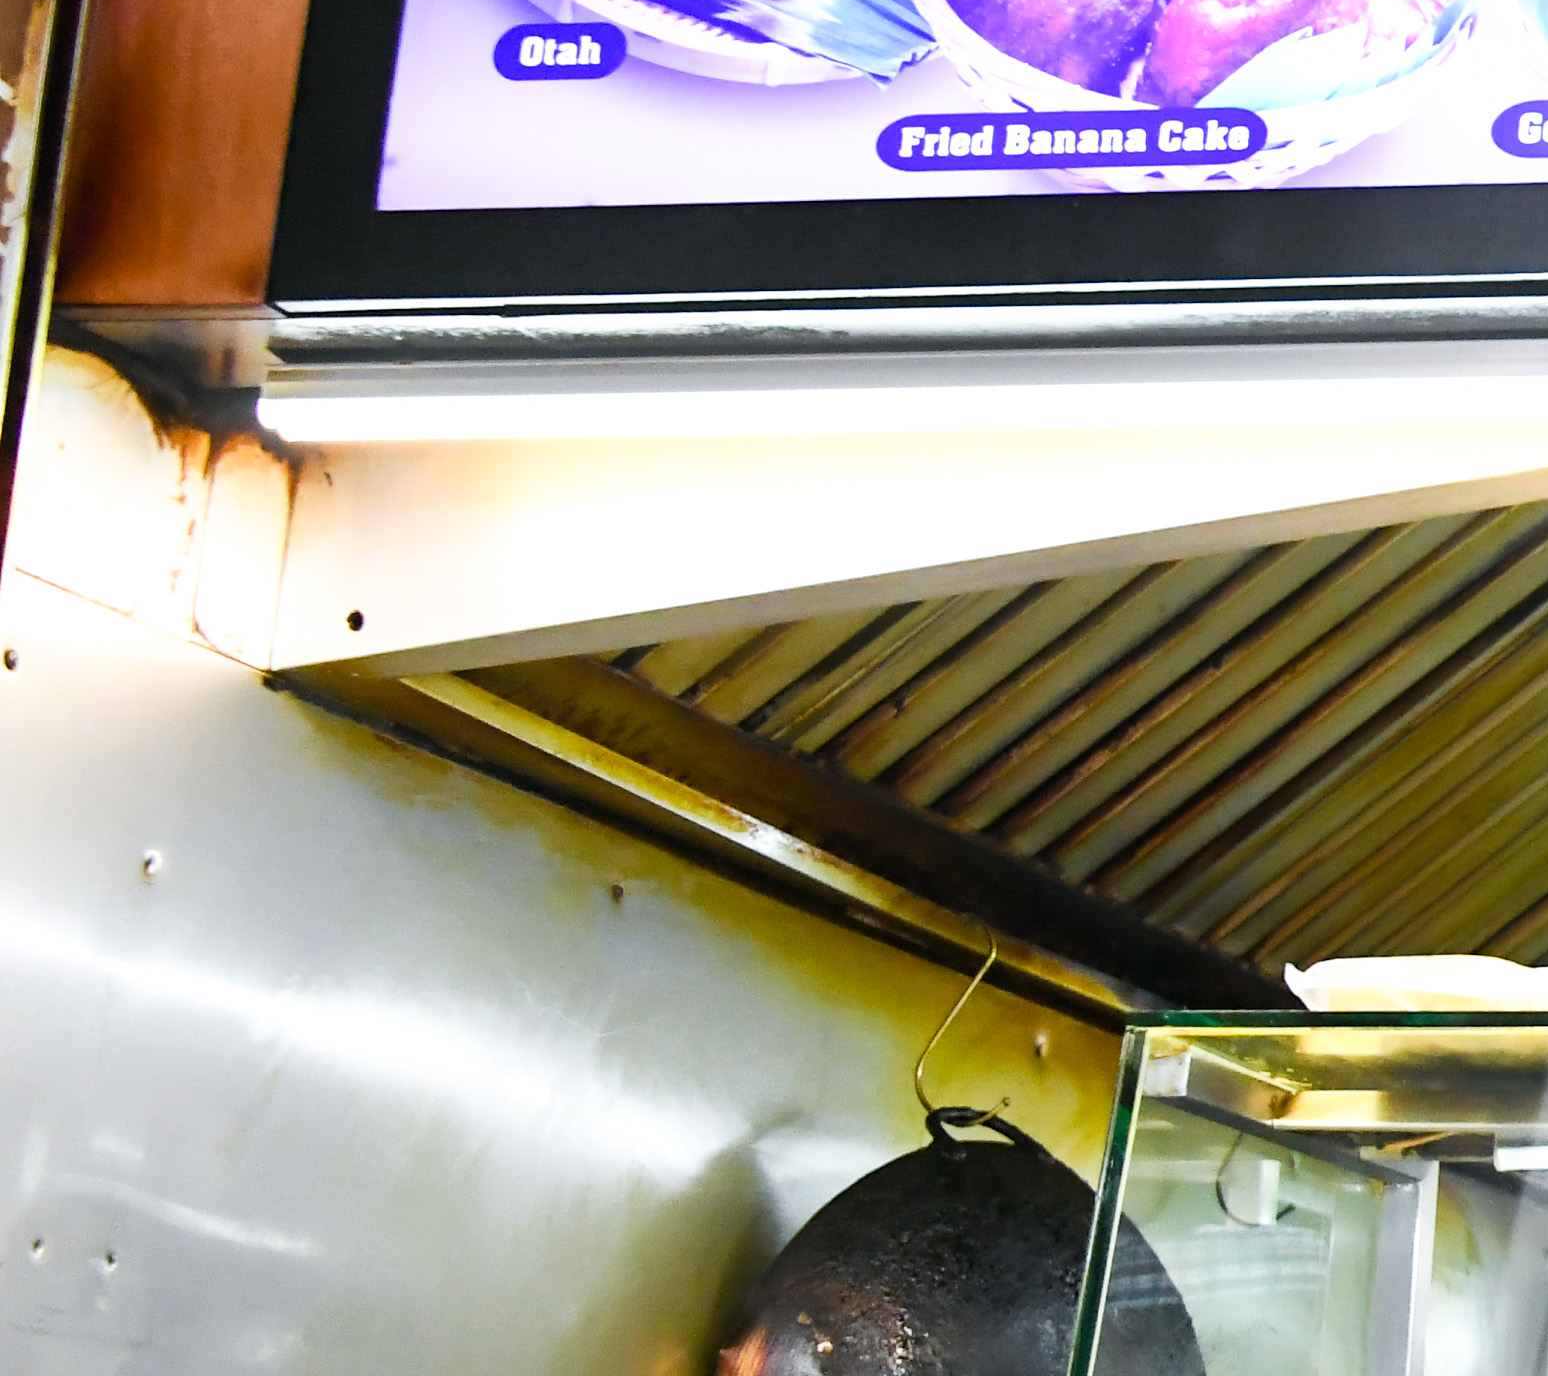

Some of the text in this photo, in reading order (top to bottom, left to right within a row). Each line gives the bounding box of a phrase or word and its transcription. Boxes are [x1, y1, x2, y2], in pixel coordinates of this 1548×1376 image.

[519, 35, 602, 67] Otah
[899, 119, 1250, 158] Fried Banana Cake
